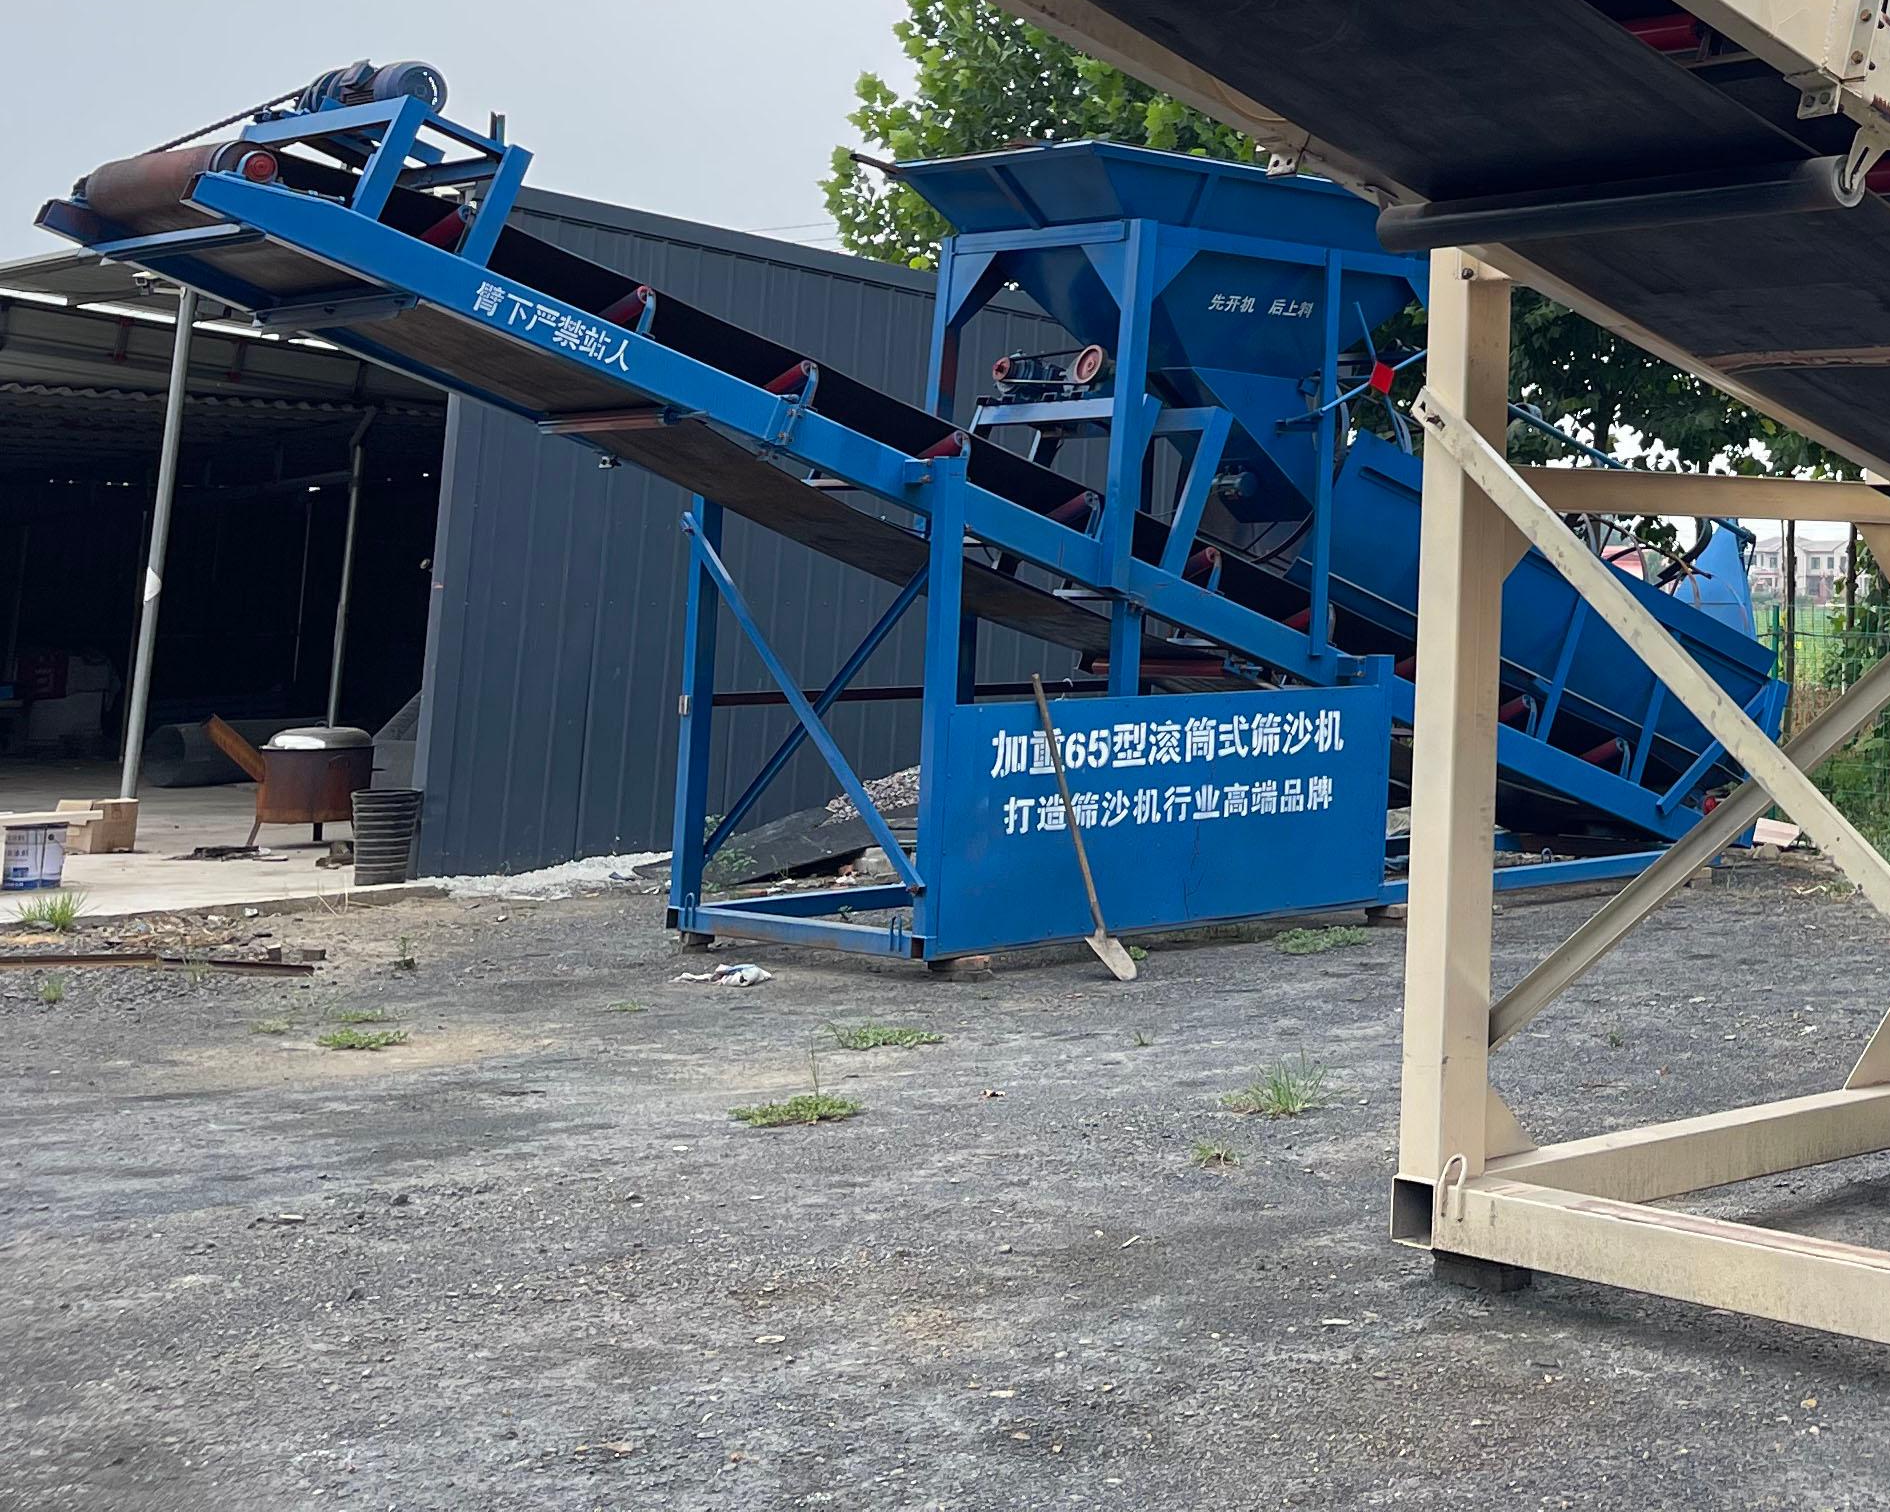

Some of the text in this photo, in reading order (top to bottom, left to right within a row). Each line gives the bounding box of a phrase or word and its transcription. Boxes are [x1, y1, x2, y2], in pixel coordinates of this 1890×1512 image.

[473, 281, 629, 372] 臂下严禁站人
[1208, 293, 1314, 319] 先开机 后上料
[990, 709, 1344, 779] 加重65型滚筒式筛沙机
[1004, 775, 1333, 835] 打造筛沙机行业高端品牌
